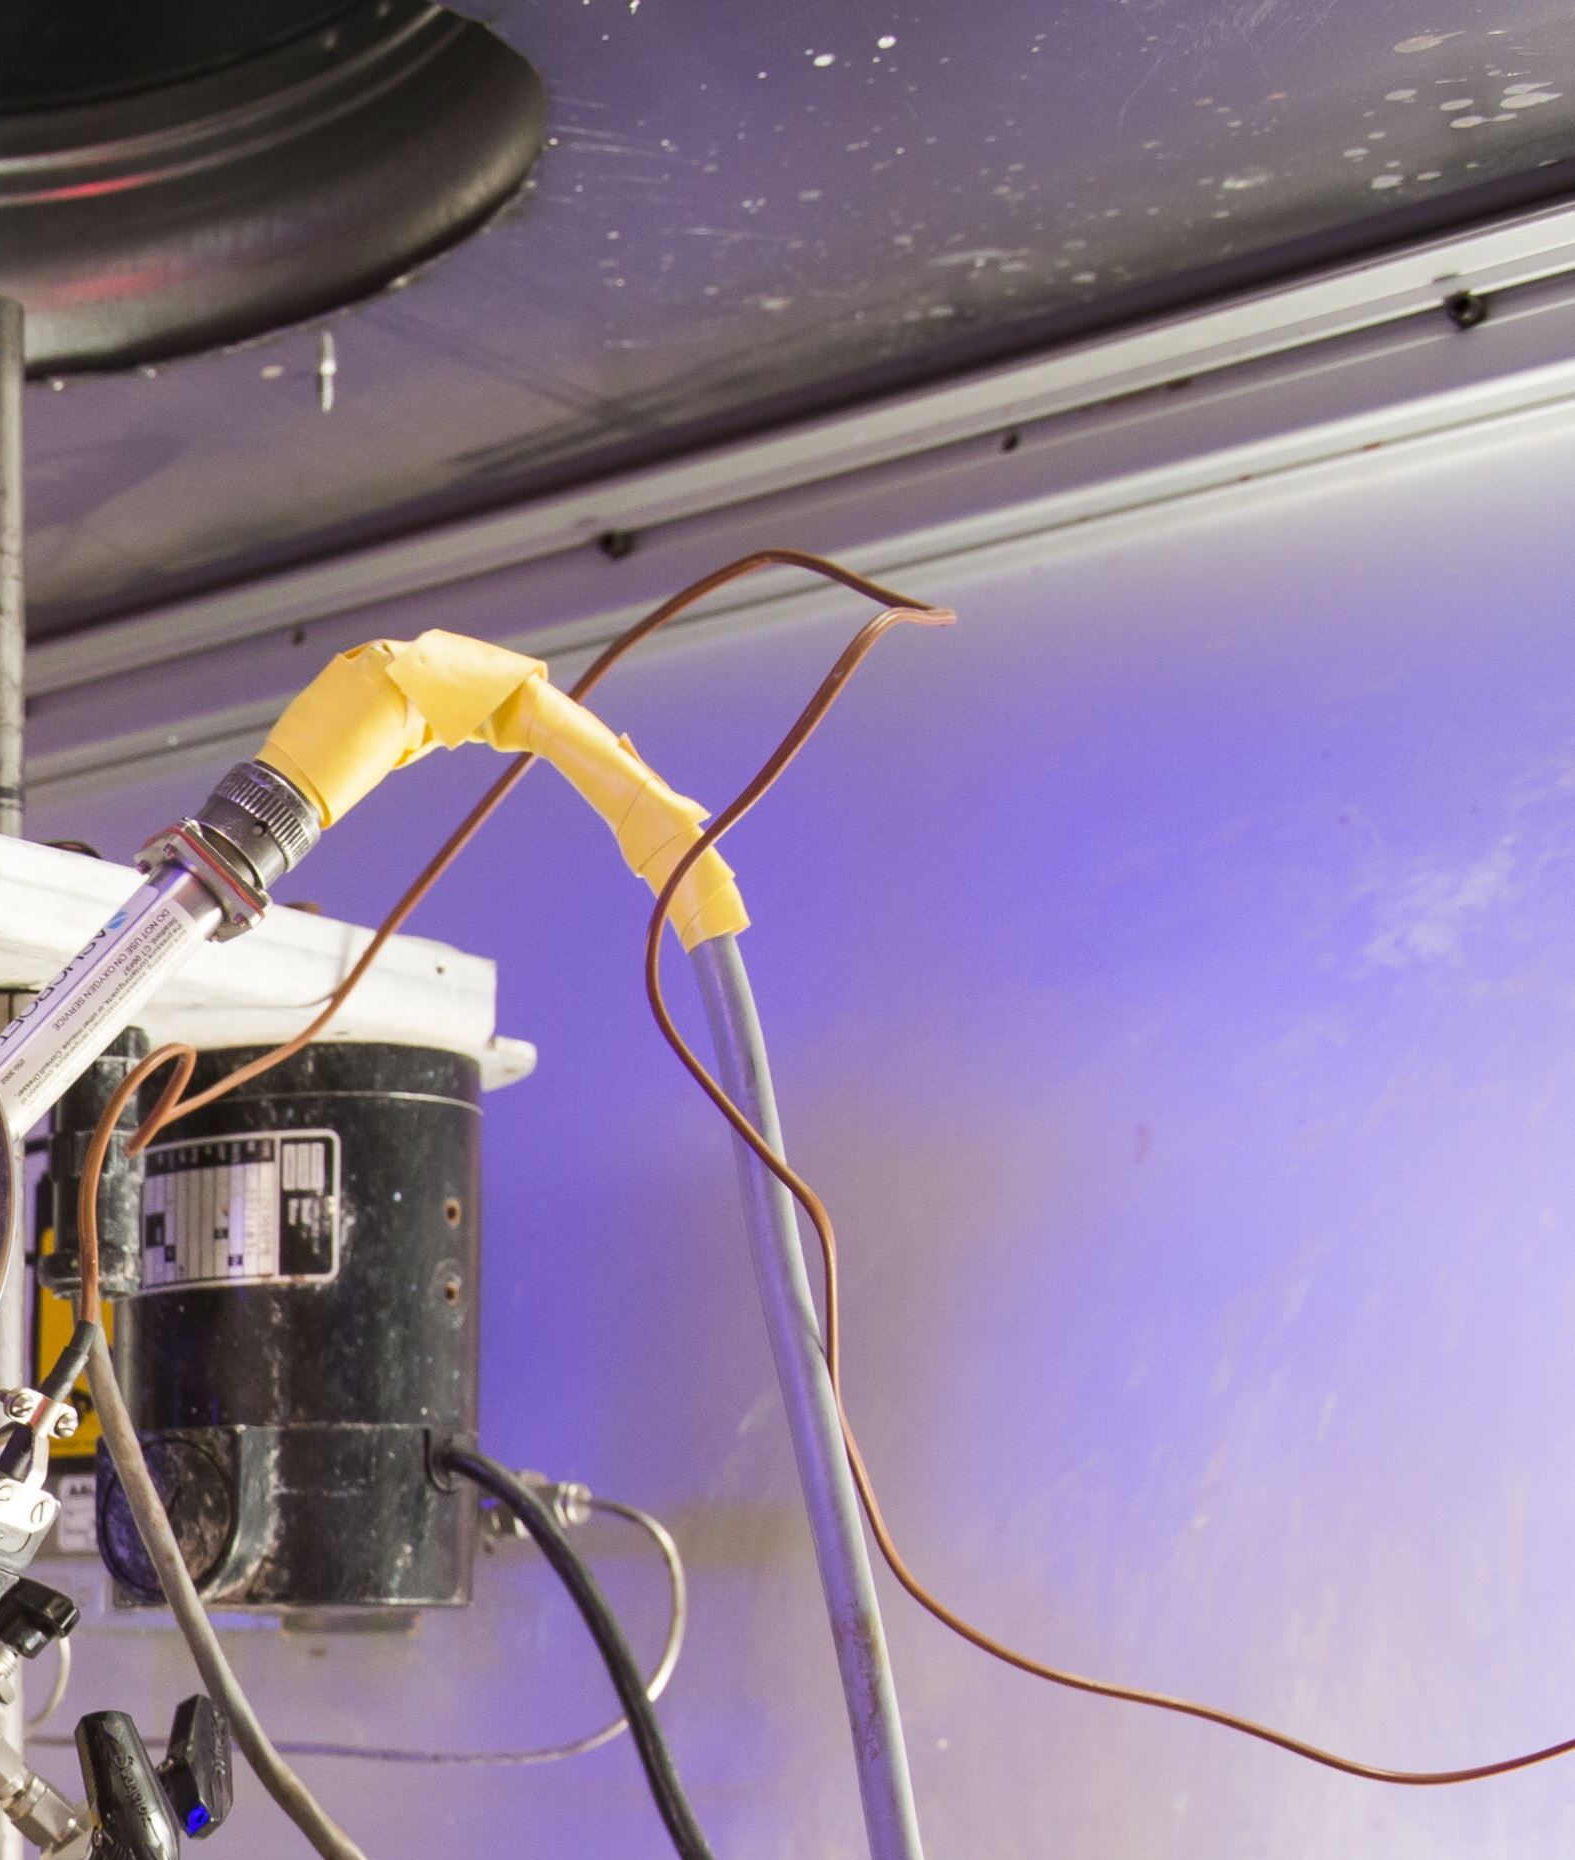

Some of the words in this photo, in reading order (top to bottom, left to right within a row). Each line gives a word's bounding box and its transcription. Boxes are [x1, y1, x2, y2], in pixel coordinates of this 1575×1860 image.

[154, 907, 171, 924] DO
[139, 920, 158, 939] NOT
[124, 936, 143, 955] USE
[112, 951, 128, 968] ON
[81, 964, 117, 999] OXYGEN
[51, 995, 87, 1032] SERVICE
